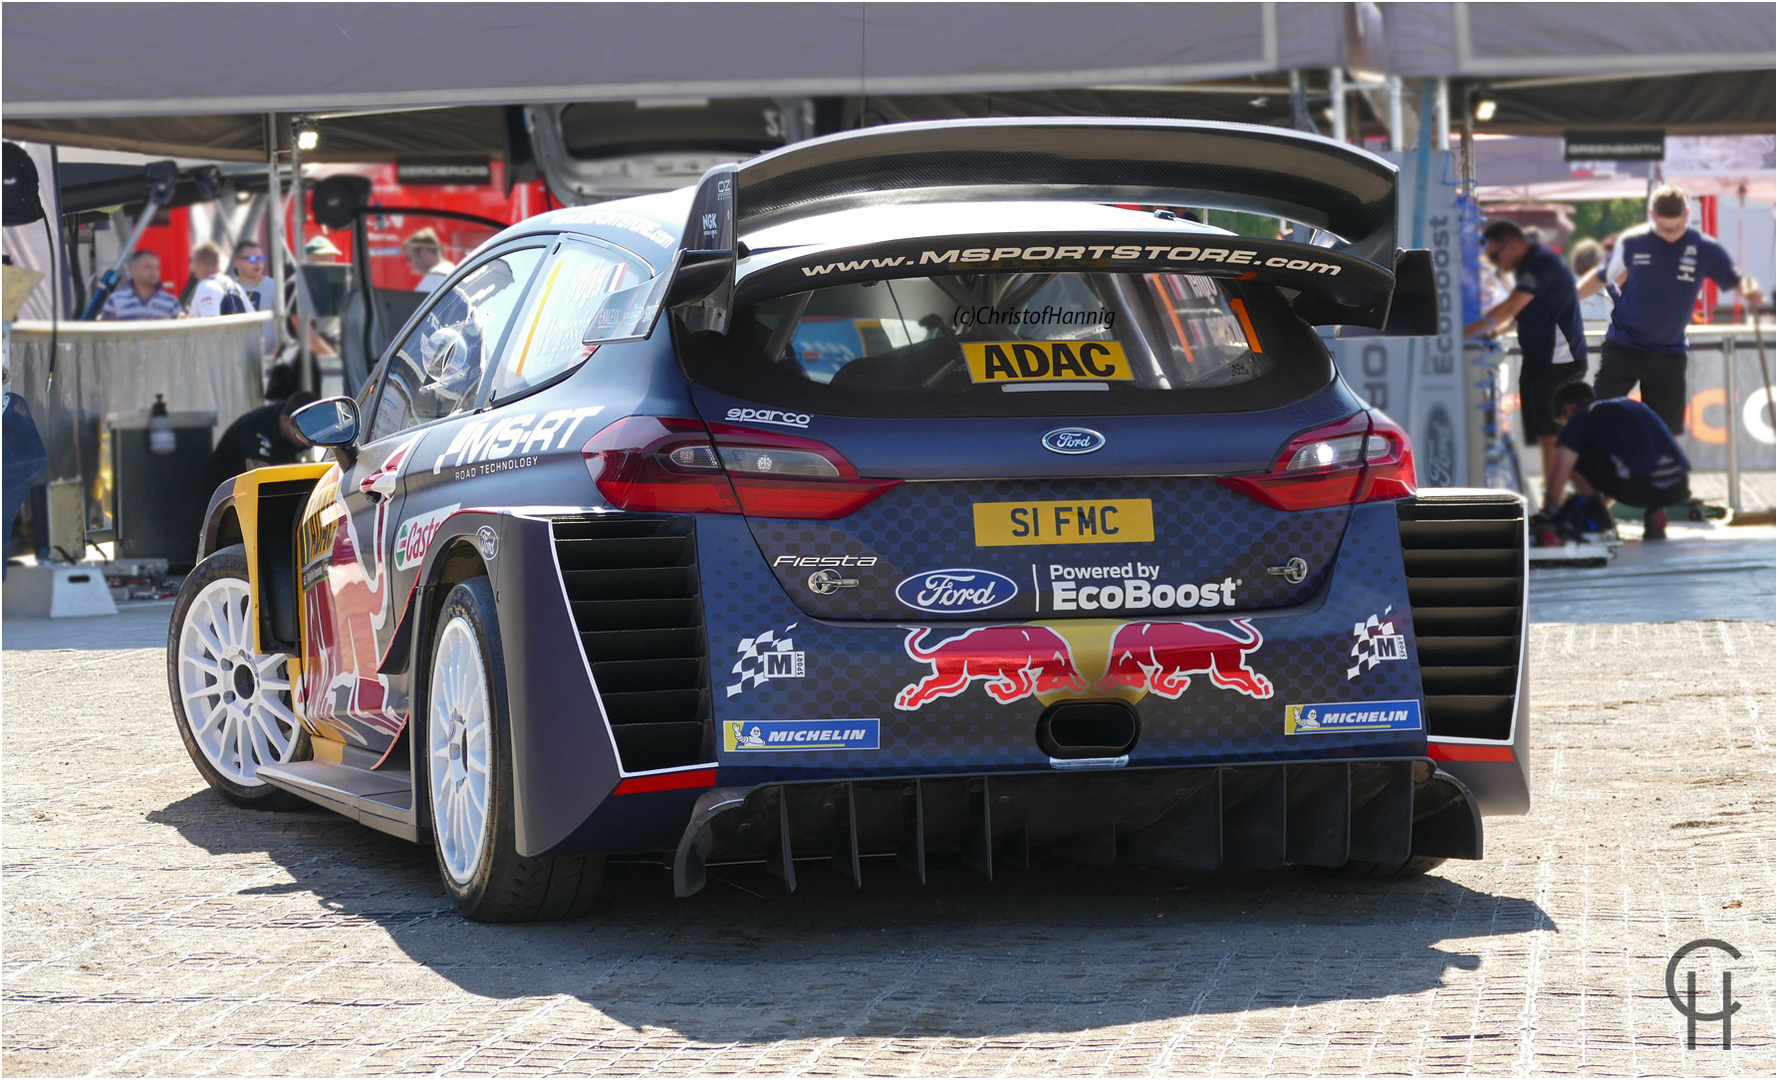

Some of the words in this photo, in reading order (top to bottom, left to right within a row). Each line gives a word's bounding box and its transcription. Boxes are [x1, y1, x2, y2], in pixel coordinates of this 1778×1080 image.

[717, 179, 731, 193] OZ
[702, 213, 718, 230] NGK
[801, 245, 1342, 277] www.MSPORTSTORE.com
[984, 342, 1116, 379] ADAC
[726, 407, 811, 425] sparco
[1056, 432, 1091, 448] Ford
[454, 468, 477, 481] ROAD
[480, 455, 539, 475] TECHNOLOGY
[1054, 505, 1120, 536] FMC
[406, 516, 441, 562] Castr
[773, 555, 878, 567] Fiesta
[1049, 562, 1134, 580] Powered
[1136, 562, 1160, 581] by
[916, 574, 996, 607] Ford
[1051, 577, 1236, 611] EcoBoost
[1376, 637, 1398, 658] M
[767, 653, 792, 675] M
[796, 652, 804, 677] SPORT
[1322, 710, 1409, 724] MICHELIN
[767, 729, 867, 742] MICHELIN
